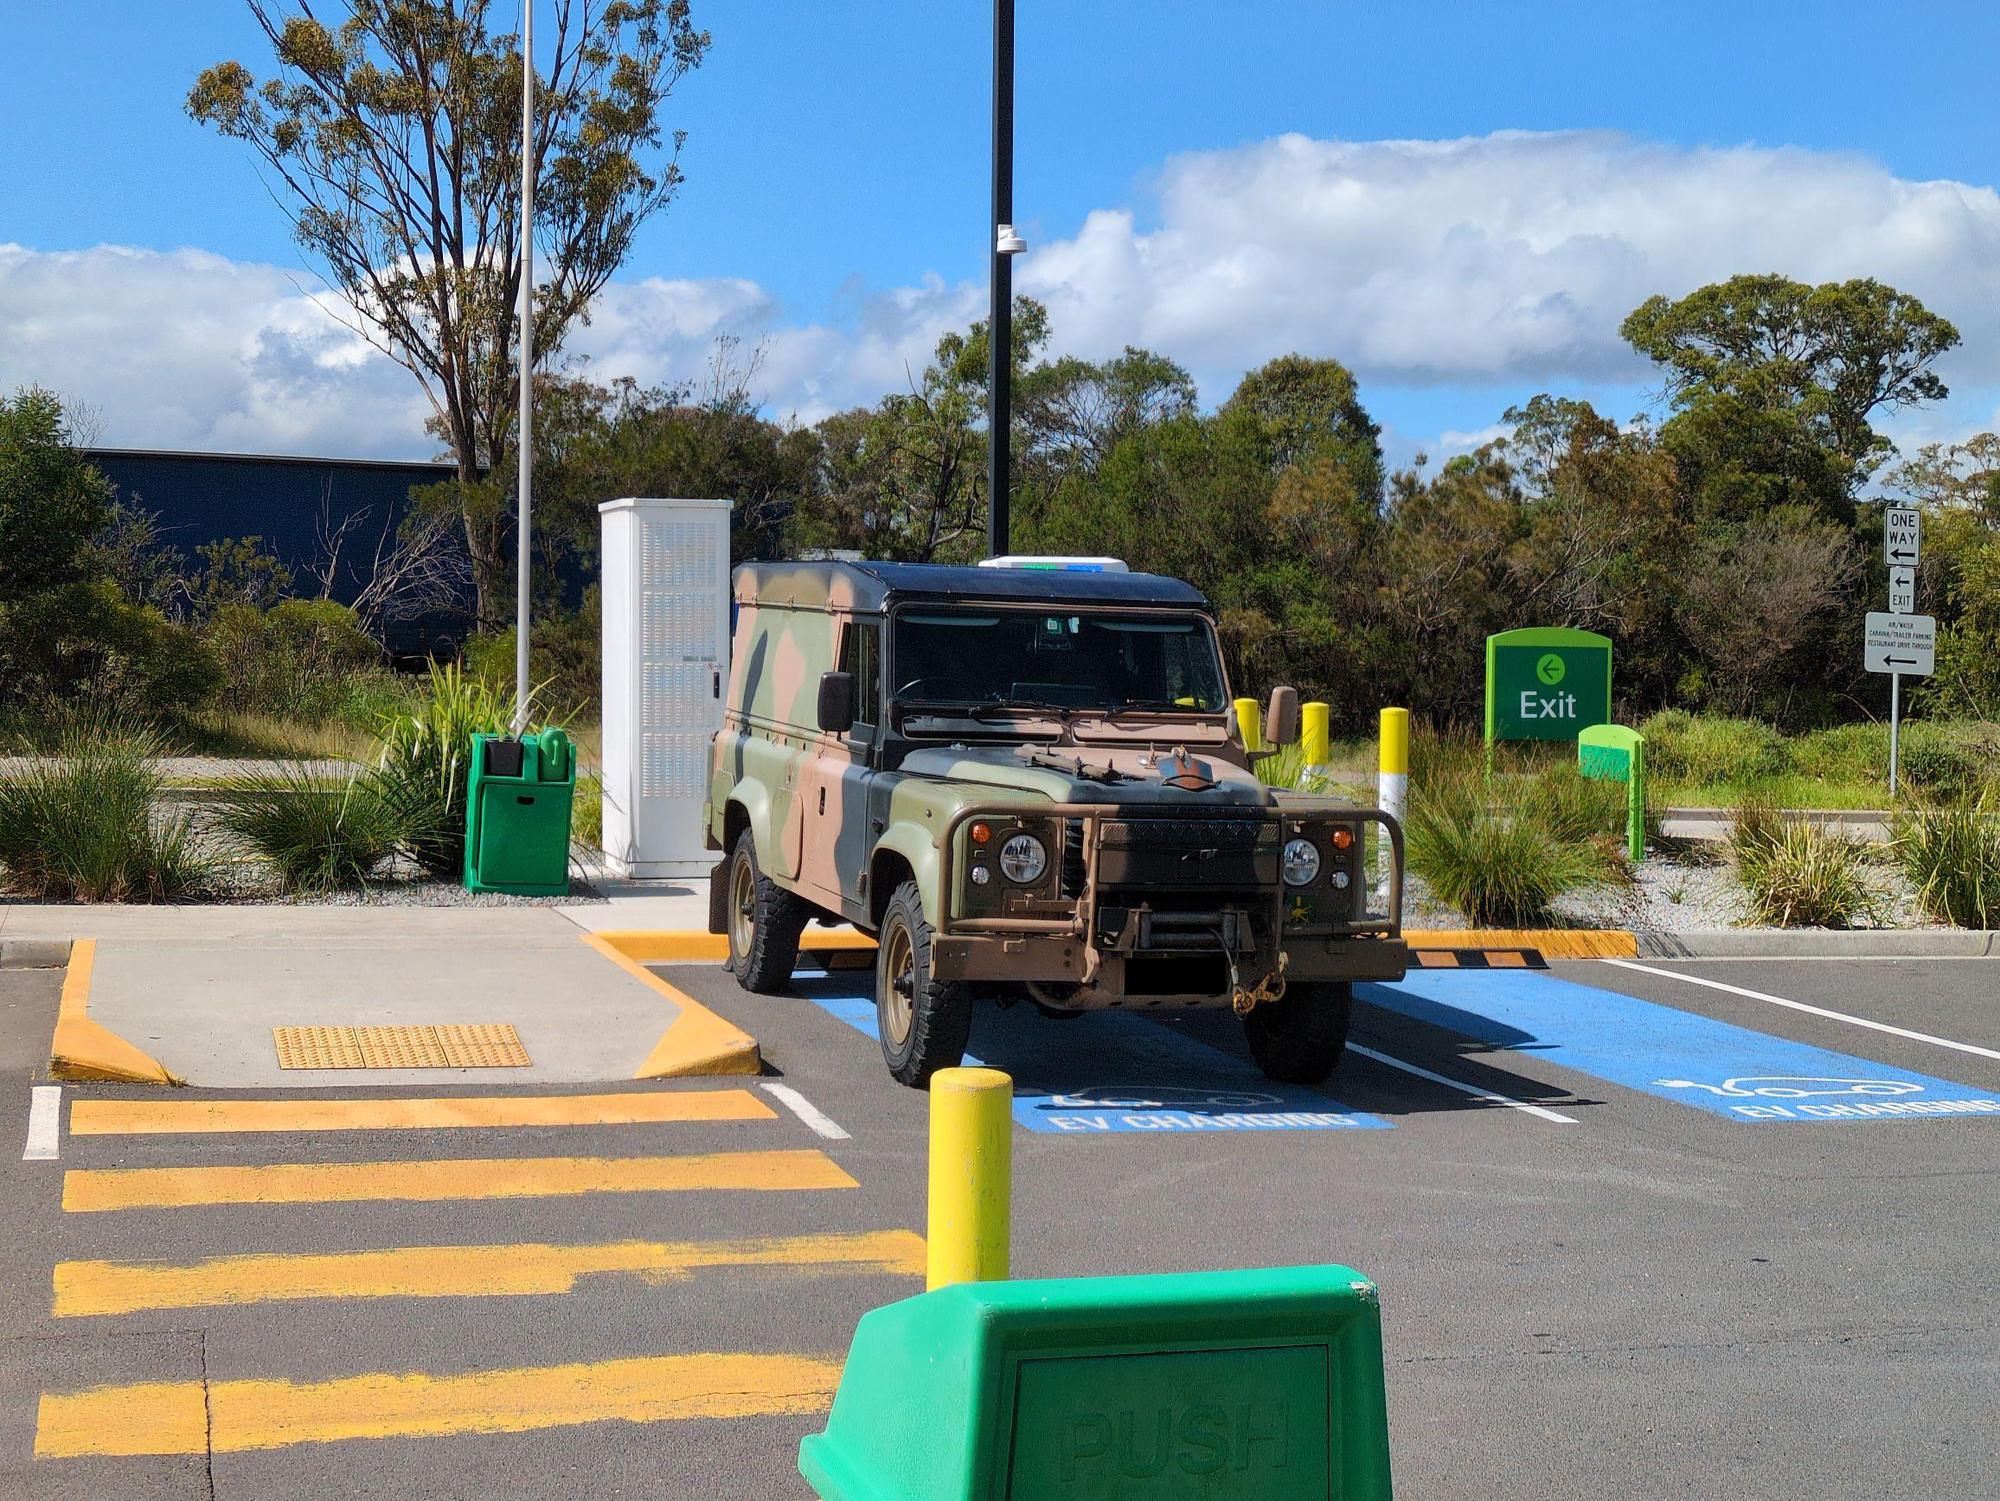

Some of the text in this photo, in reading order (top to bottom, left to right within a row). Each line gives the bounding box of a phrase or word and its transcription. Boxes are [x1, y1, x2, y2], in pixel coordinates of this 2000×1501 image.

[1891, 514, 1915, 528] ONE
[1889, 531, 1917, 545] WAY
[1892, 595, 1911, 607] EXIT
[1913, 632, 1932, 640] PARKING
[1867, 639, 1896, 648] RESTAURANT
[1897, 641, 1911, 649] DRIVE
[1520, 691, 1577, 719] Exit
[1730, 1105, 1797, 1118] EV
[1048, 1112, 1359, 1130] EV CHARGING
[1060, 1400, 1290, 1483] PUSH
